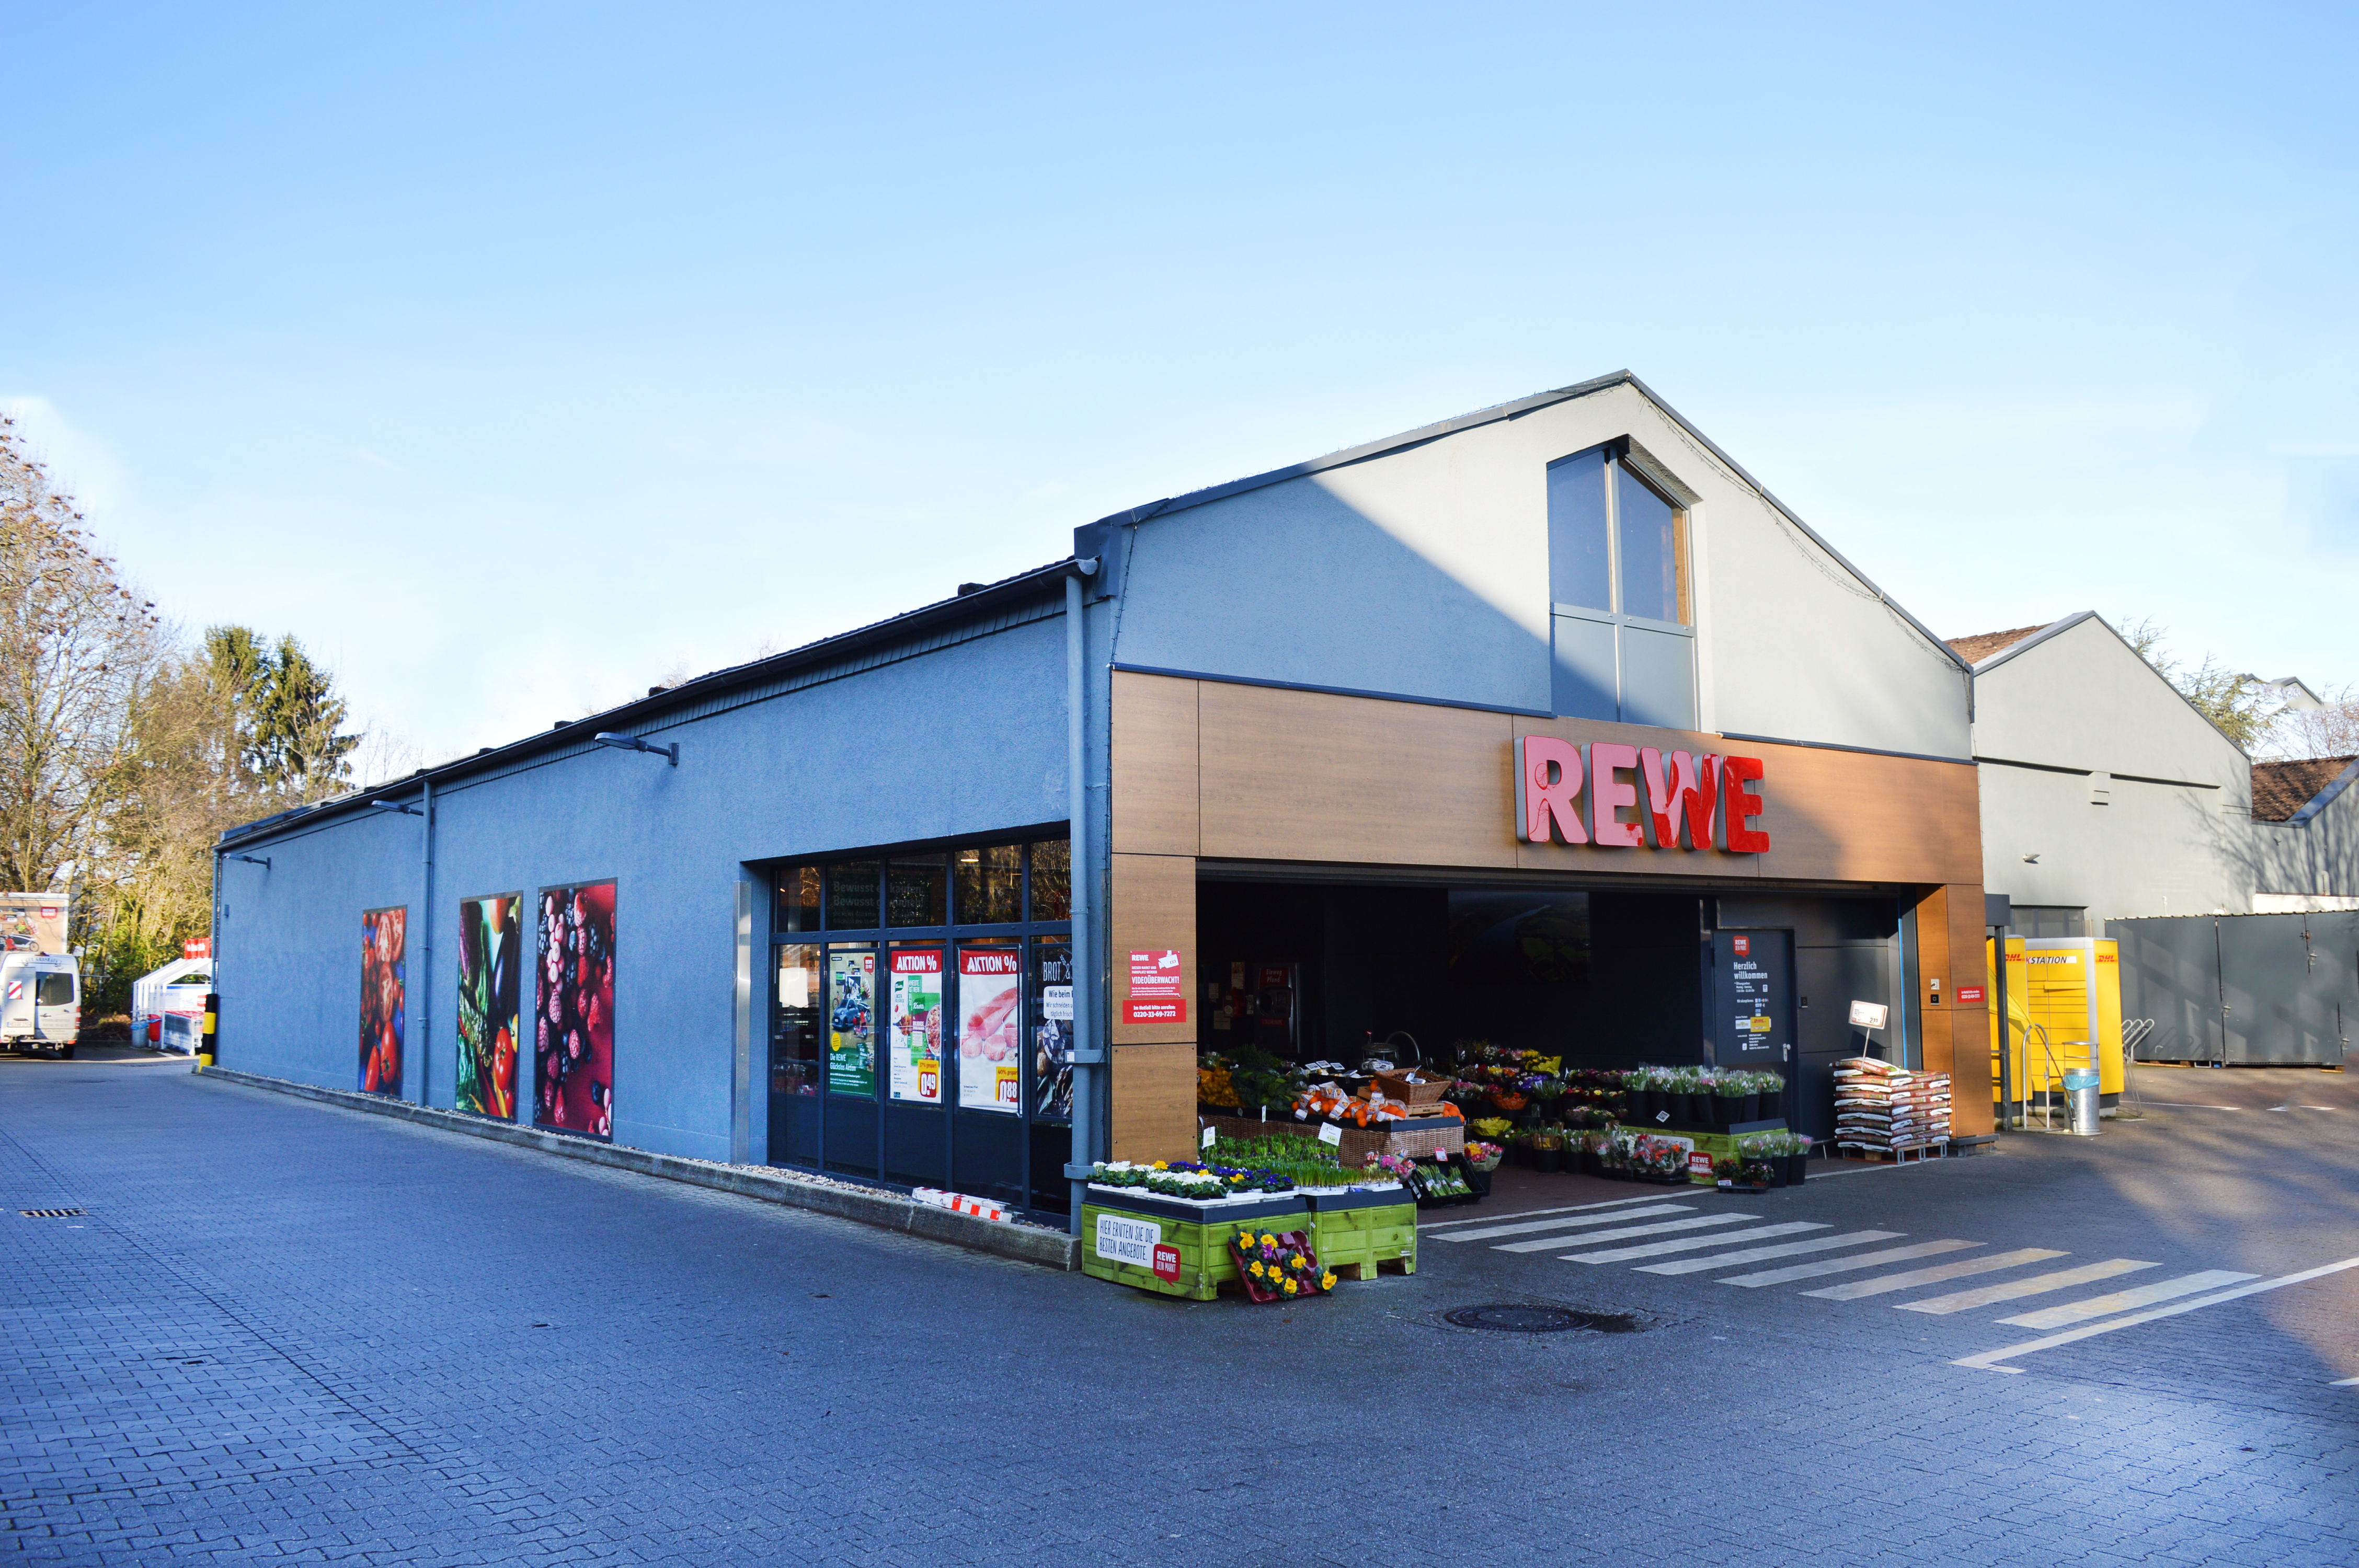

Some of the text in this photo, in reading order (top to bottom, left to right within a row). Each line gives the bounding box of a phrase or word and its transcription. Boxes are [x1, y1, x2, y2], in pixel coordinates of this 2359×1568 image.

[1515, 735, 1770, 852] REWE
[833, 881, 924, 894] Bewusst ekaufen.
[833, 894, 875, 906] Bewusst
[897, 955, 937, 971] AKTION %
[967, 955, 1017, 972] AKTION %
[1734, 961, 1757, 970] Herzlich
[1043, 962, 1071, 981] BROT &
[1734, 971, 1768, 979] willkommen
[1131, 975, 1179, 984] VIDEOÜBERWACHT!
[830, 1062, 845, 1070] Glückslos
[921, 1074, 936, 1095] 0.49
[1100, 1219, 1111, 1235] HIER
[1113, 1221, 1133, 1239] ERNTEN
[1135, 1226, 1143, 1241] SIE
[1100, 1236, 1147, 1261] BESTEN ANGEBOTE.
[1157, 1251, 1176, 1263] REWE
[1165, 1262, 1176, 1273] MARKT
